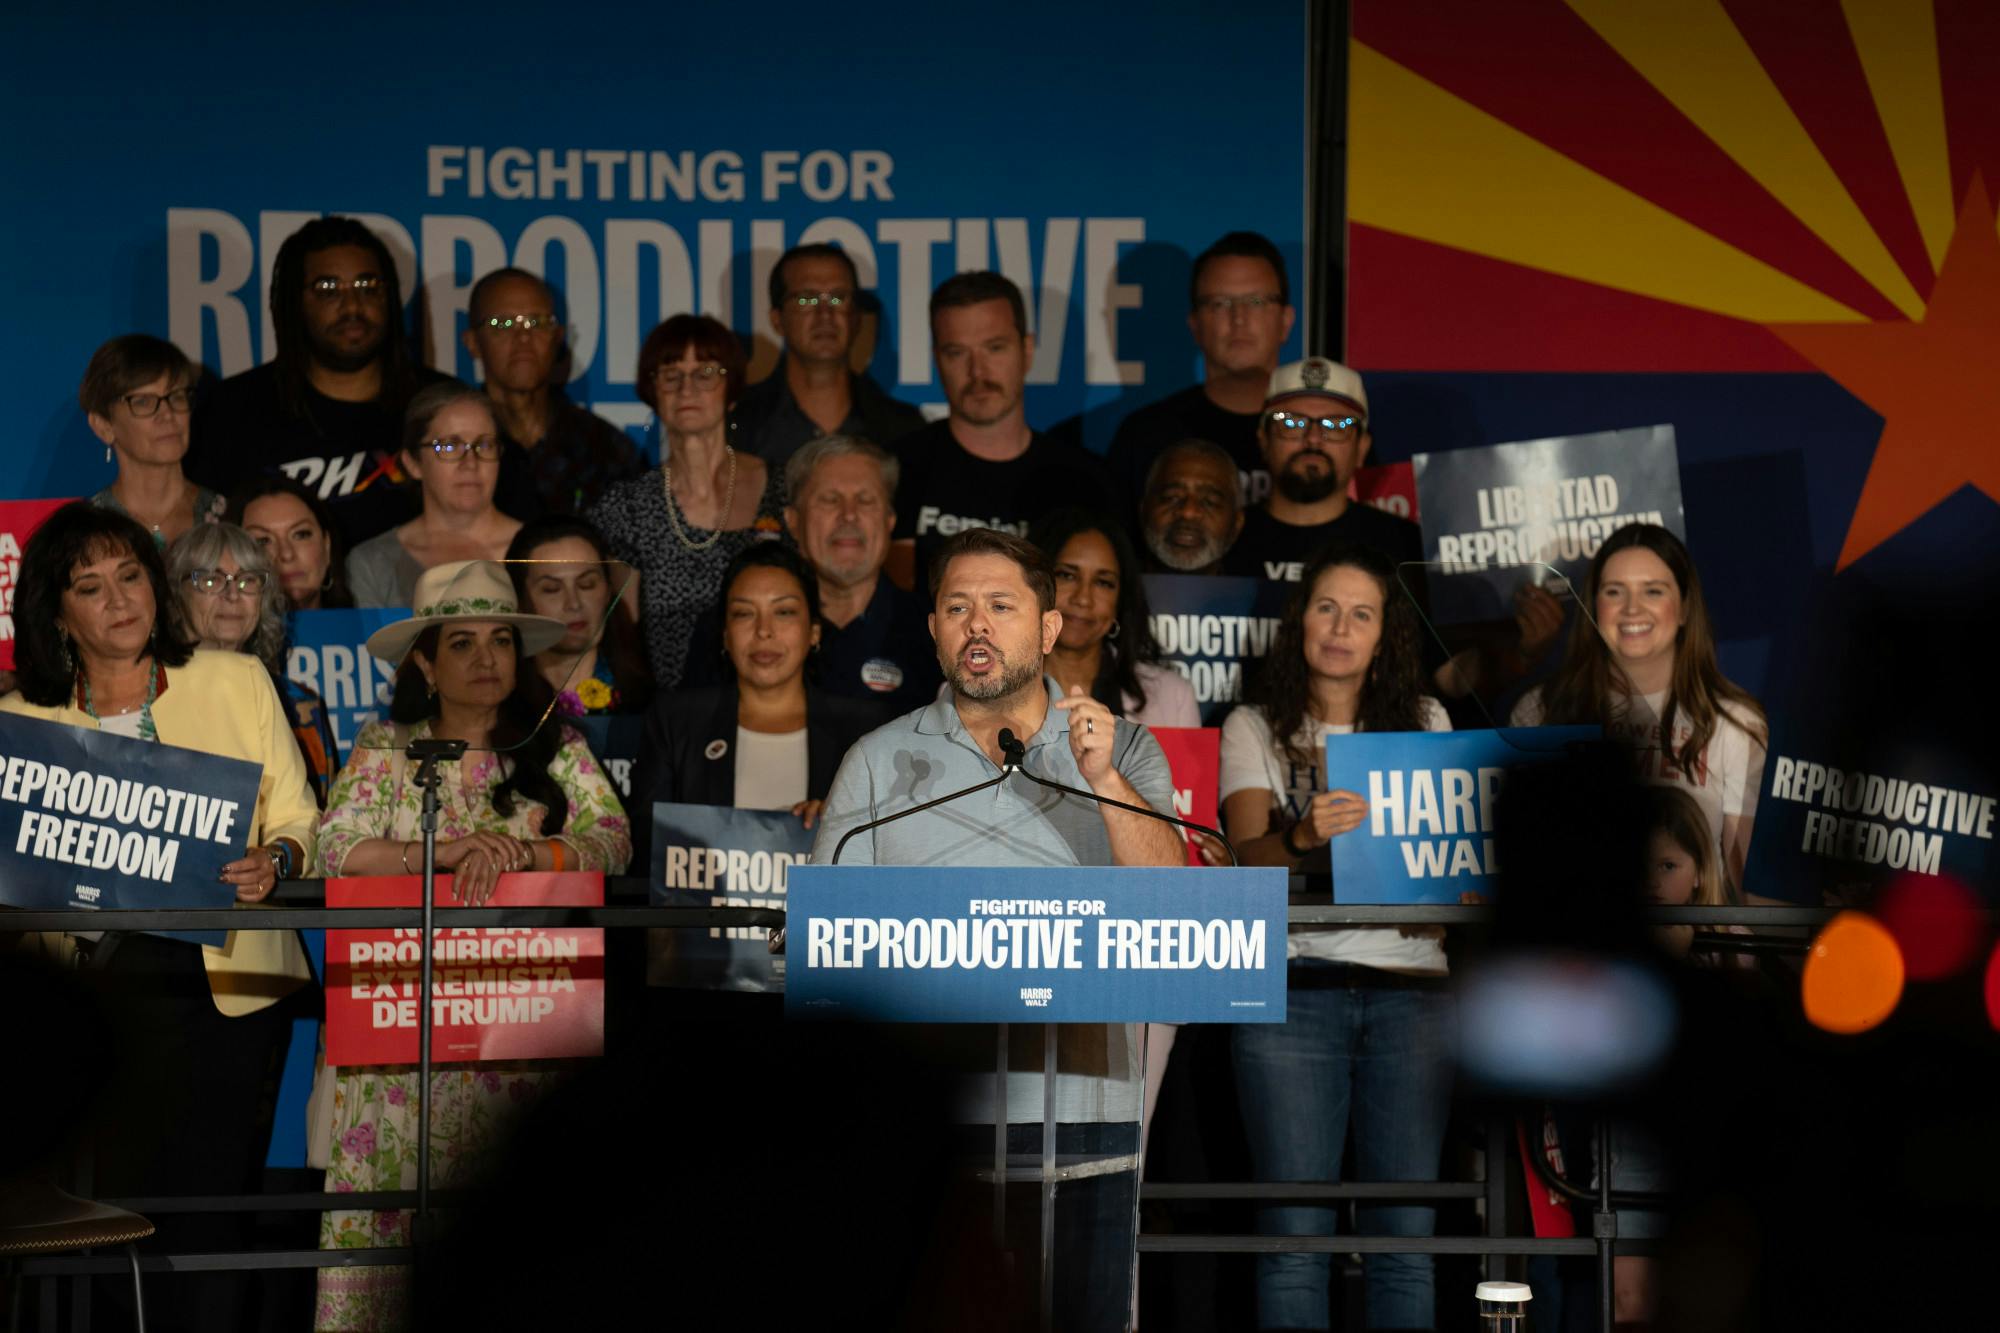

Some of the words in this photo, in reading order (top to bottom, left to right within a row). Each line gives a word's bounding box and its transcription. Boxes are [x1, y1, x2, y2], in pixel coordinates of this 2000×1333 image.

[427, 145, 746, 202] FIGHTING
[761, 150, 896, 202] FOR
[1477, 474, 1619, 529] LIBRTAD
[1438, 510, 1664, 576] REPROUCT
[1771, 755, 1998, 839] REPRODUCTIVE
[16, 810, 180, 883] FREEDOM
[665, 845, 814, 894] REPROD
[1801, 810, 1944, 876] FREEDOM
[969, 900, 1063, 915] FIGHTING
[1067, 900, 1106, 915] FOR
[350, 932, 578, 969] PROHIBICIÓN
[807, 917, 1083, 970] REPRODUCTIVE
[1097, 919, 1266, 970] FREEDOM
[372, 1000, 418, 1029] DE
[431, 996, 554, 1026] TRUMP
[1020, 987, 1053, 1000] HARRIS
